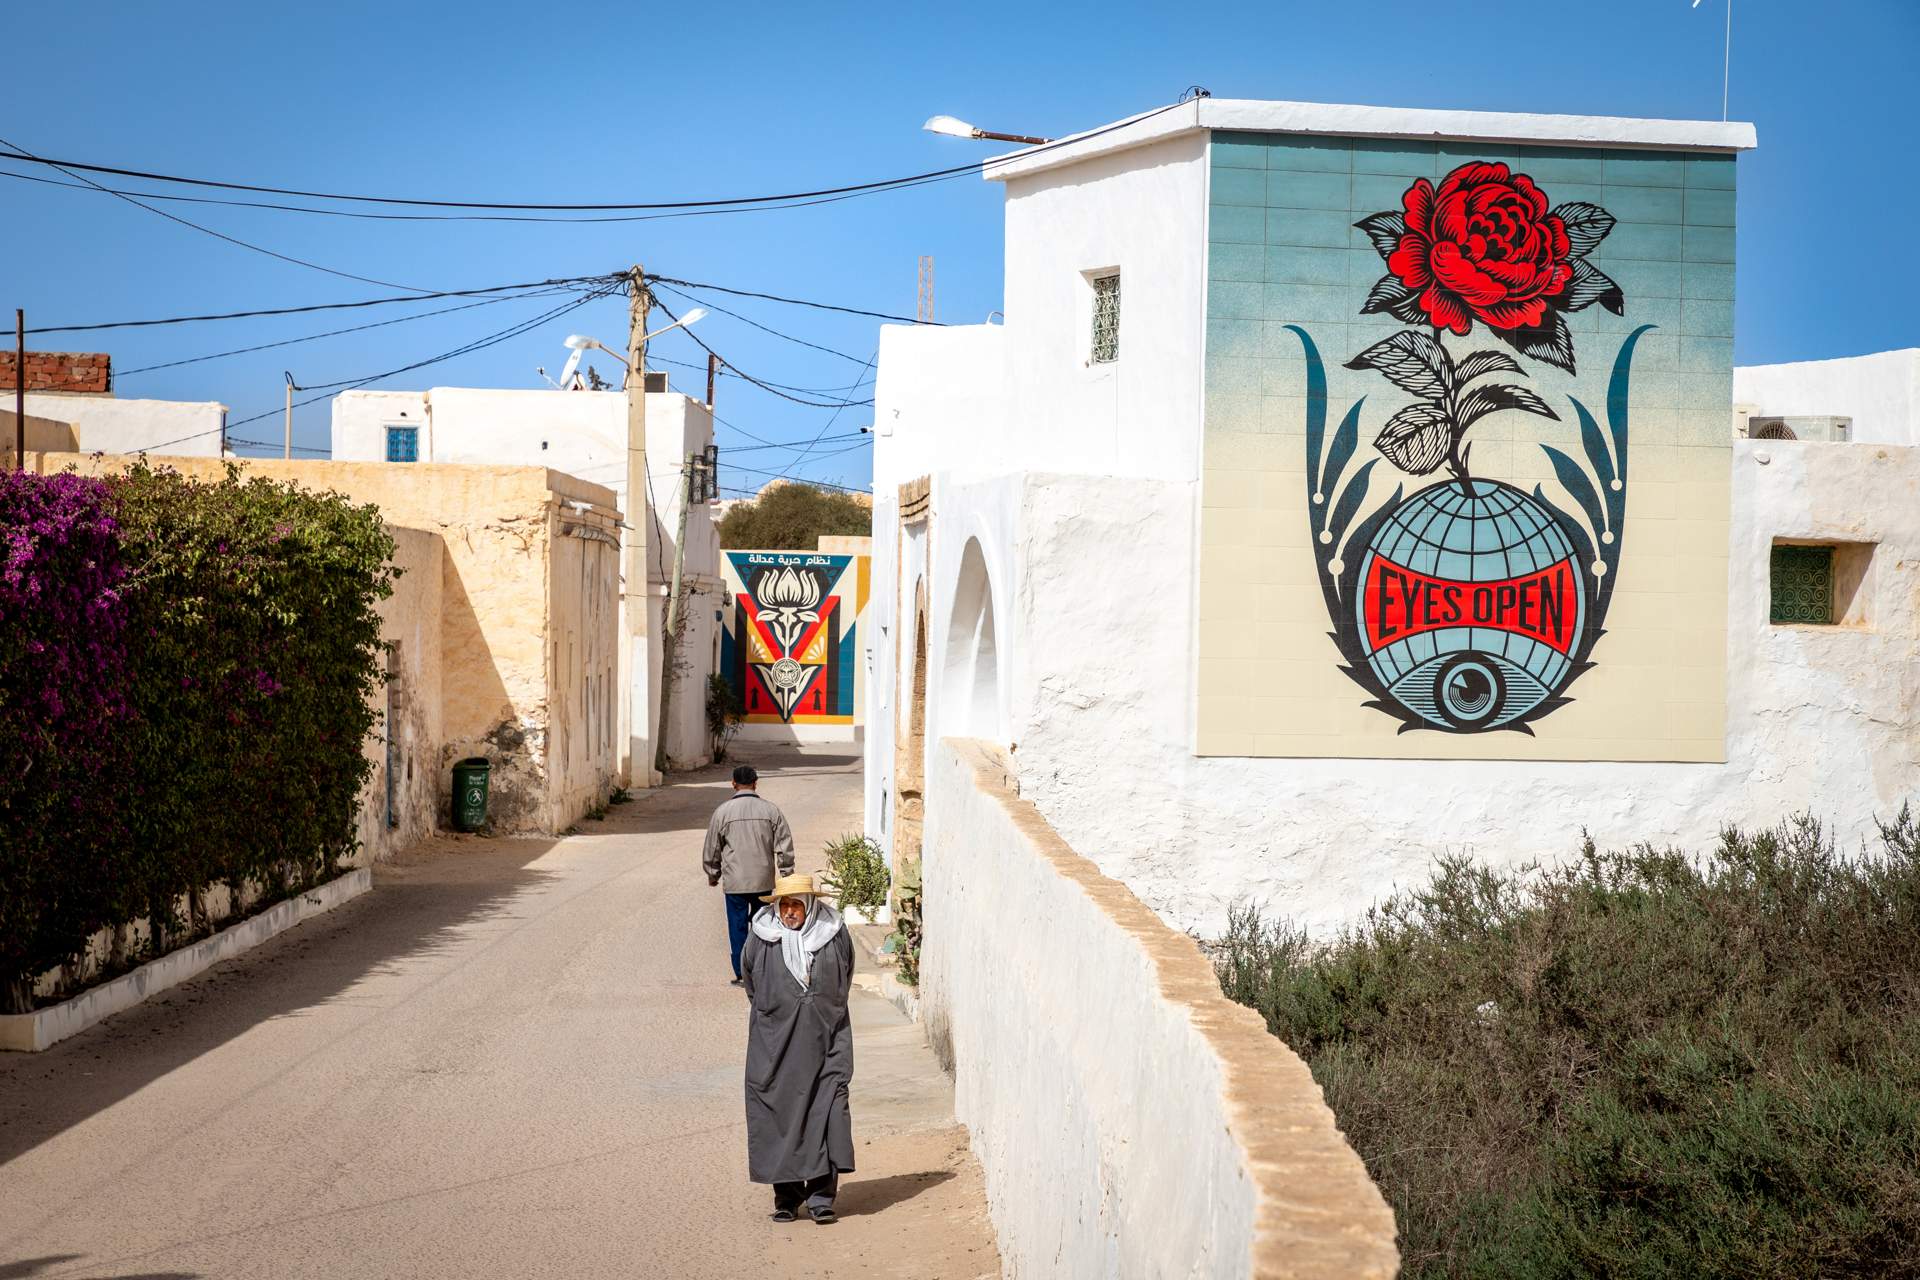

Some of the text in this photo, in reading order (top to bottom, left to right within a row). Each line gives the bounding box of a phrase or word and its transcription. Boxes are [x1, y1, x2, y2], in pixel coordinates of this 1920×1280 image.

[778, 555, 801, 566] حرية
[1379, 565, 1564, 644] EYES OPEN
